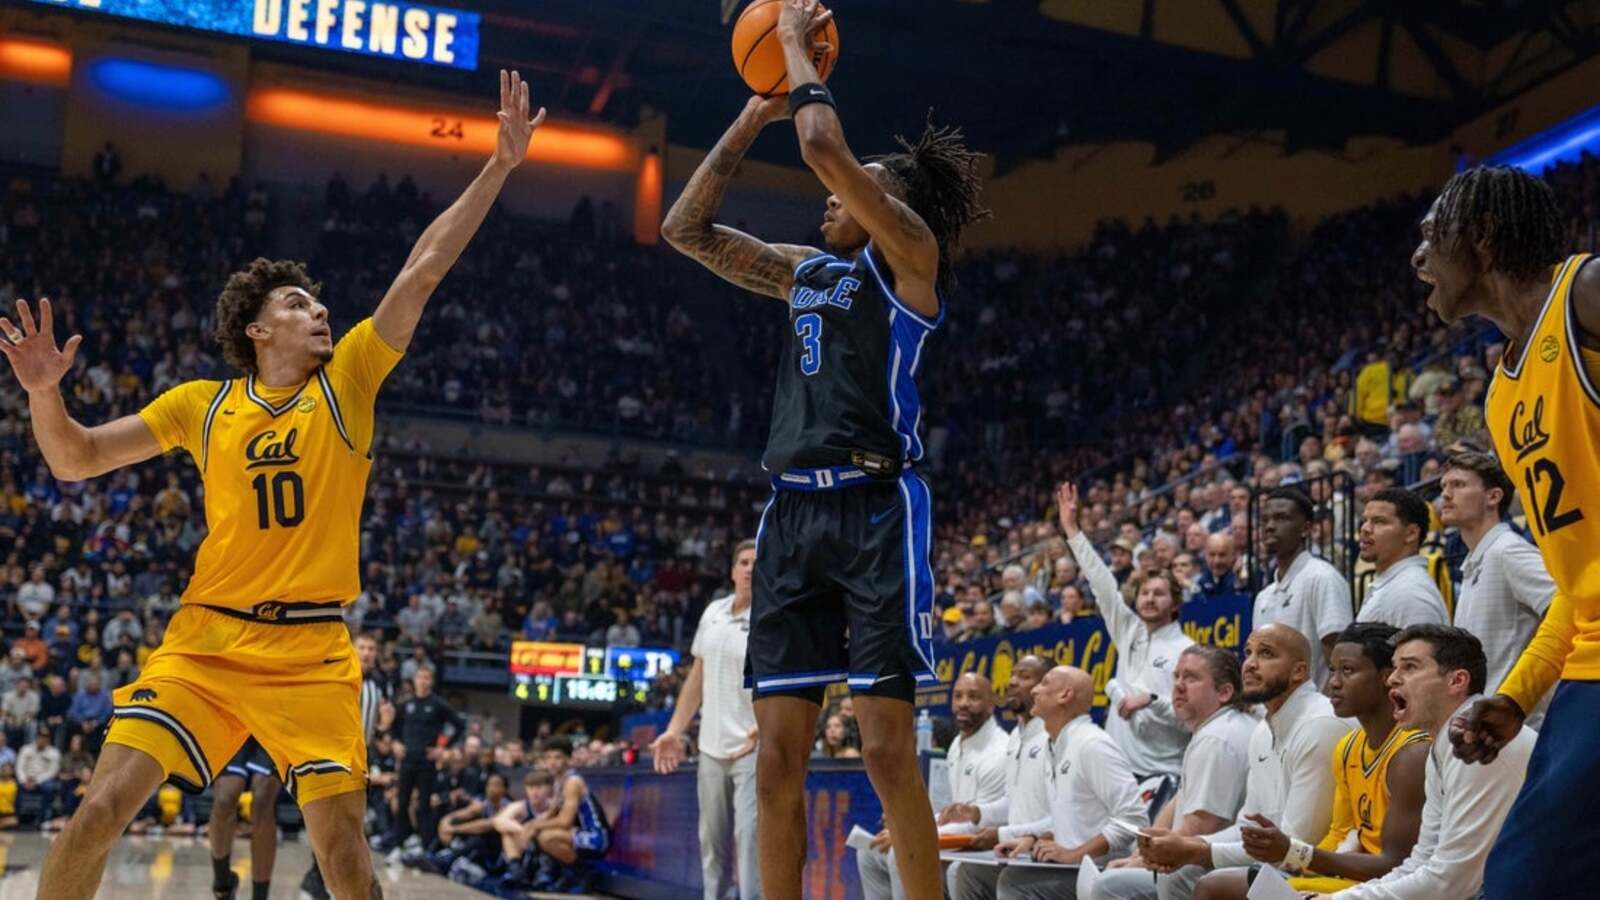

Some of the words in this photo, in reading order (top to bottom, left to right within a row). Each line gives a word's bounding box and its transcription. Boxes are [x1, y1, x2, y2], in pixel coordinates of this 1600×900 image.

[253, 0, 458, 64] DEFENSE
[431, 117, 464, 139] 24
[795, 312, 823, 376] 3
[245, 427, 300, 471] Cal
[1508, 394, 1550, 464] Cal
[252, 471, 305, 529] 10
[1524, 457, 1584, 537] 12
[256, 603, 282, 620] Cal
[1214, 613, 1241, 649] Cal
[1358, 793, 1374, 831] Cal
